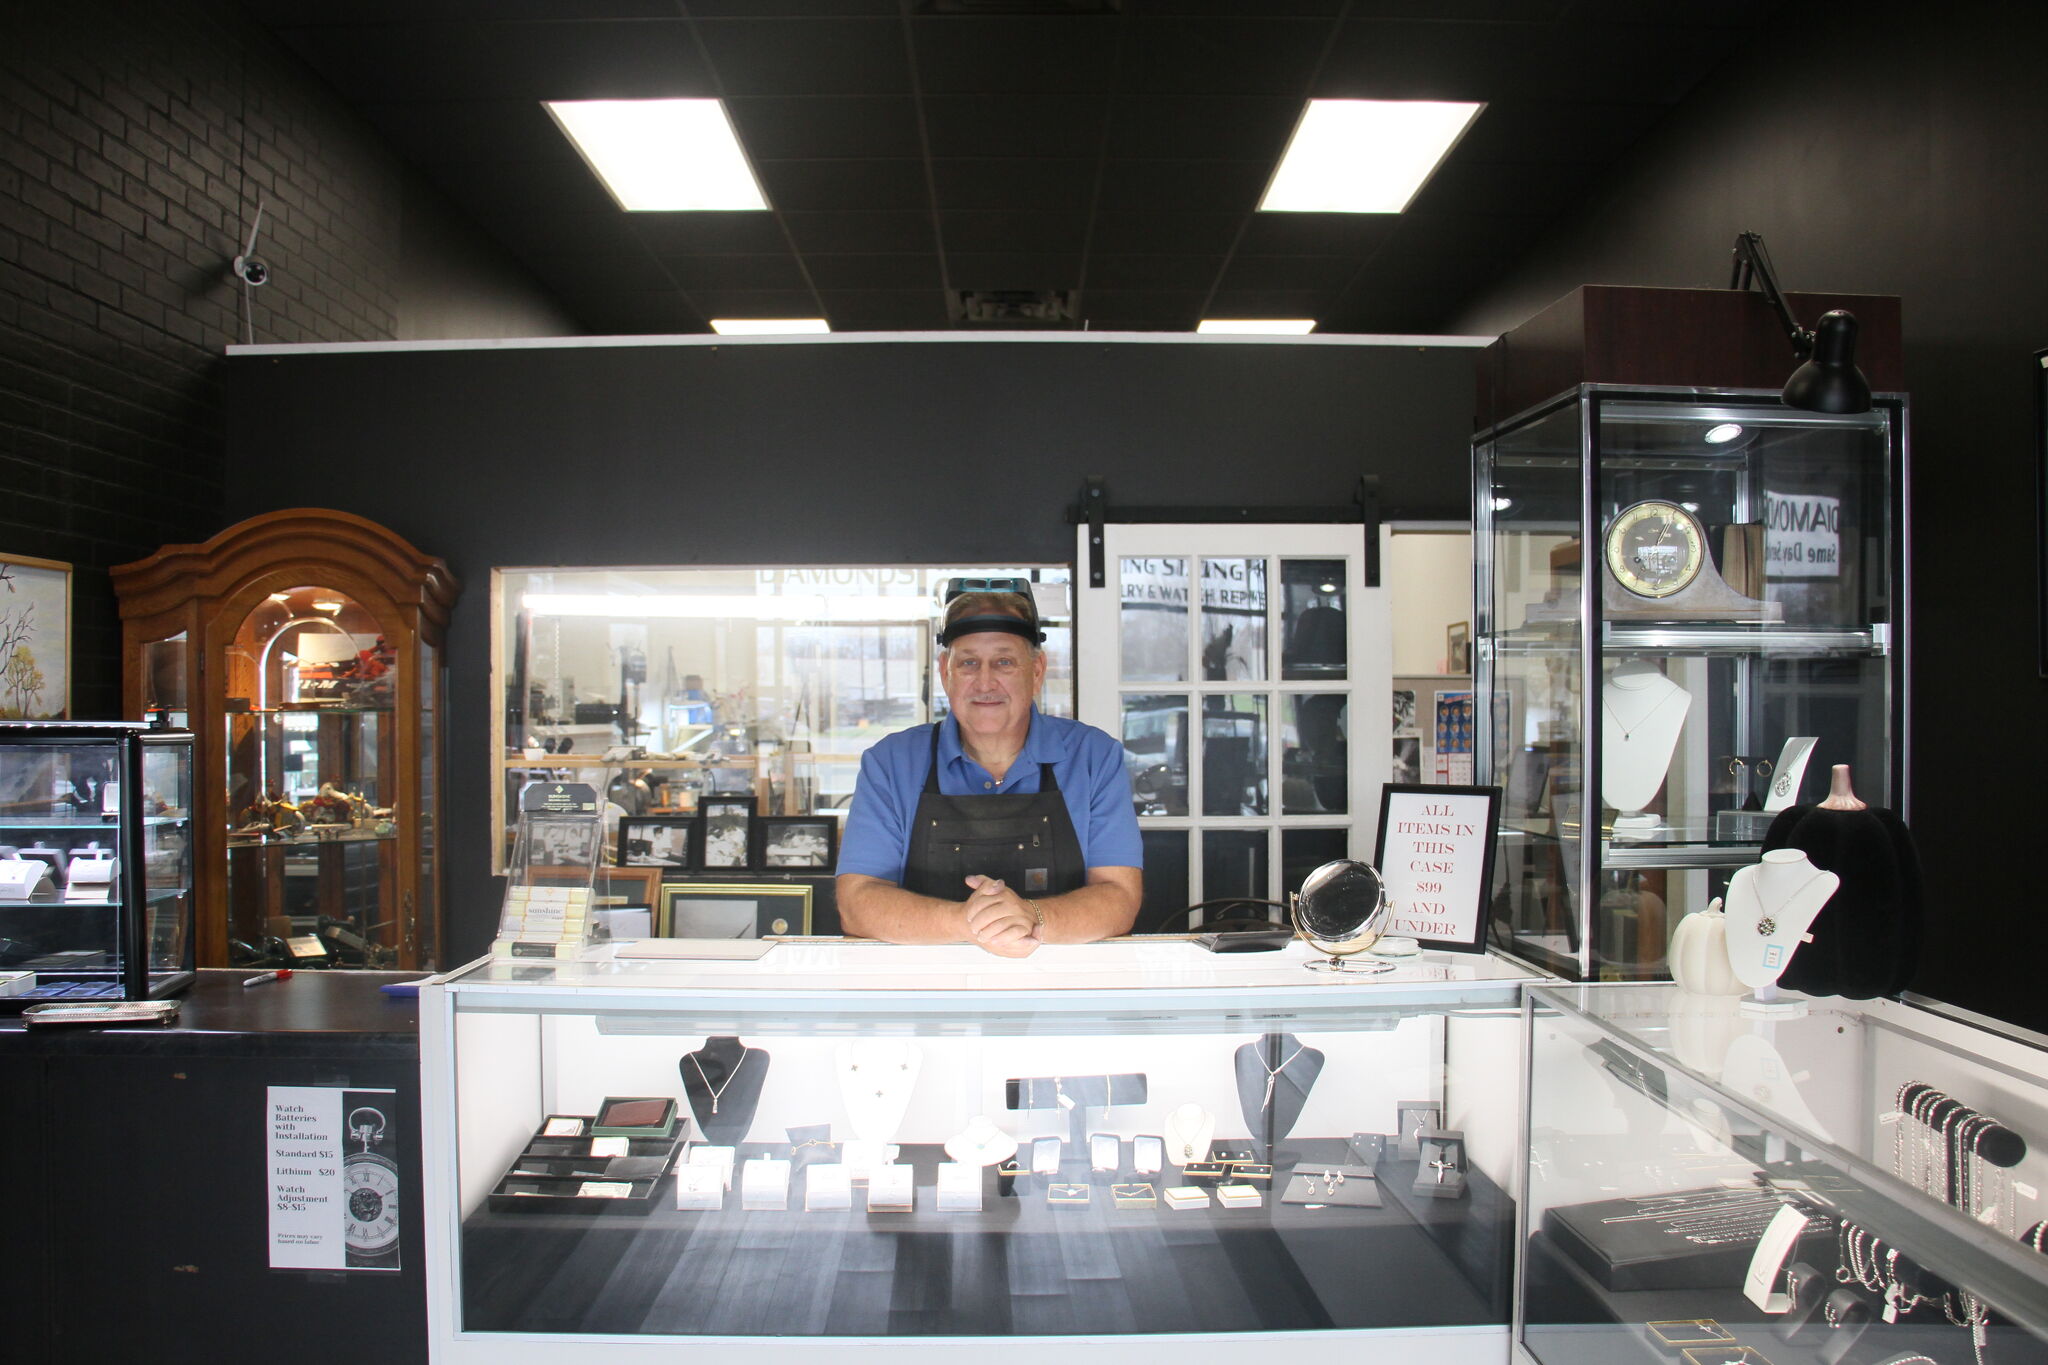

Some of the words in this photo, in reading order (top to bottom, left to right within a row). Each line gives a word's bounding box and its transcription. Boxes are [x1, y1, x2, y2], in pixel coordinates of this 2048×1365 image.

[1421, 804, 1455, 817] ALL
[1397, 822, 1451, 836] ITEMS
[1455, 824, 1475, 837] IN
[1413, 841, 1455, 855] THIS
[1410, 860, 1454, 874] CASE
[1408, 902, 1446, 915] AND
[1394, 919, 1456, 936] UNDER
[275, 1104, 304, 1113] Watch
[275, 1113, 317, 1122] Batteries
[275, 1123, 296, 1131] with
[275, 1131, 328, 1141] Installation
[276, 1149, 317, 1158] Standard
[319, 1150, 334, 1159] $15
[276, 1167, 312, 1176] Lithium
[276, 1184, 305, 1193] Watch
[277, 1194, 328, 1203] Adjustment
